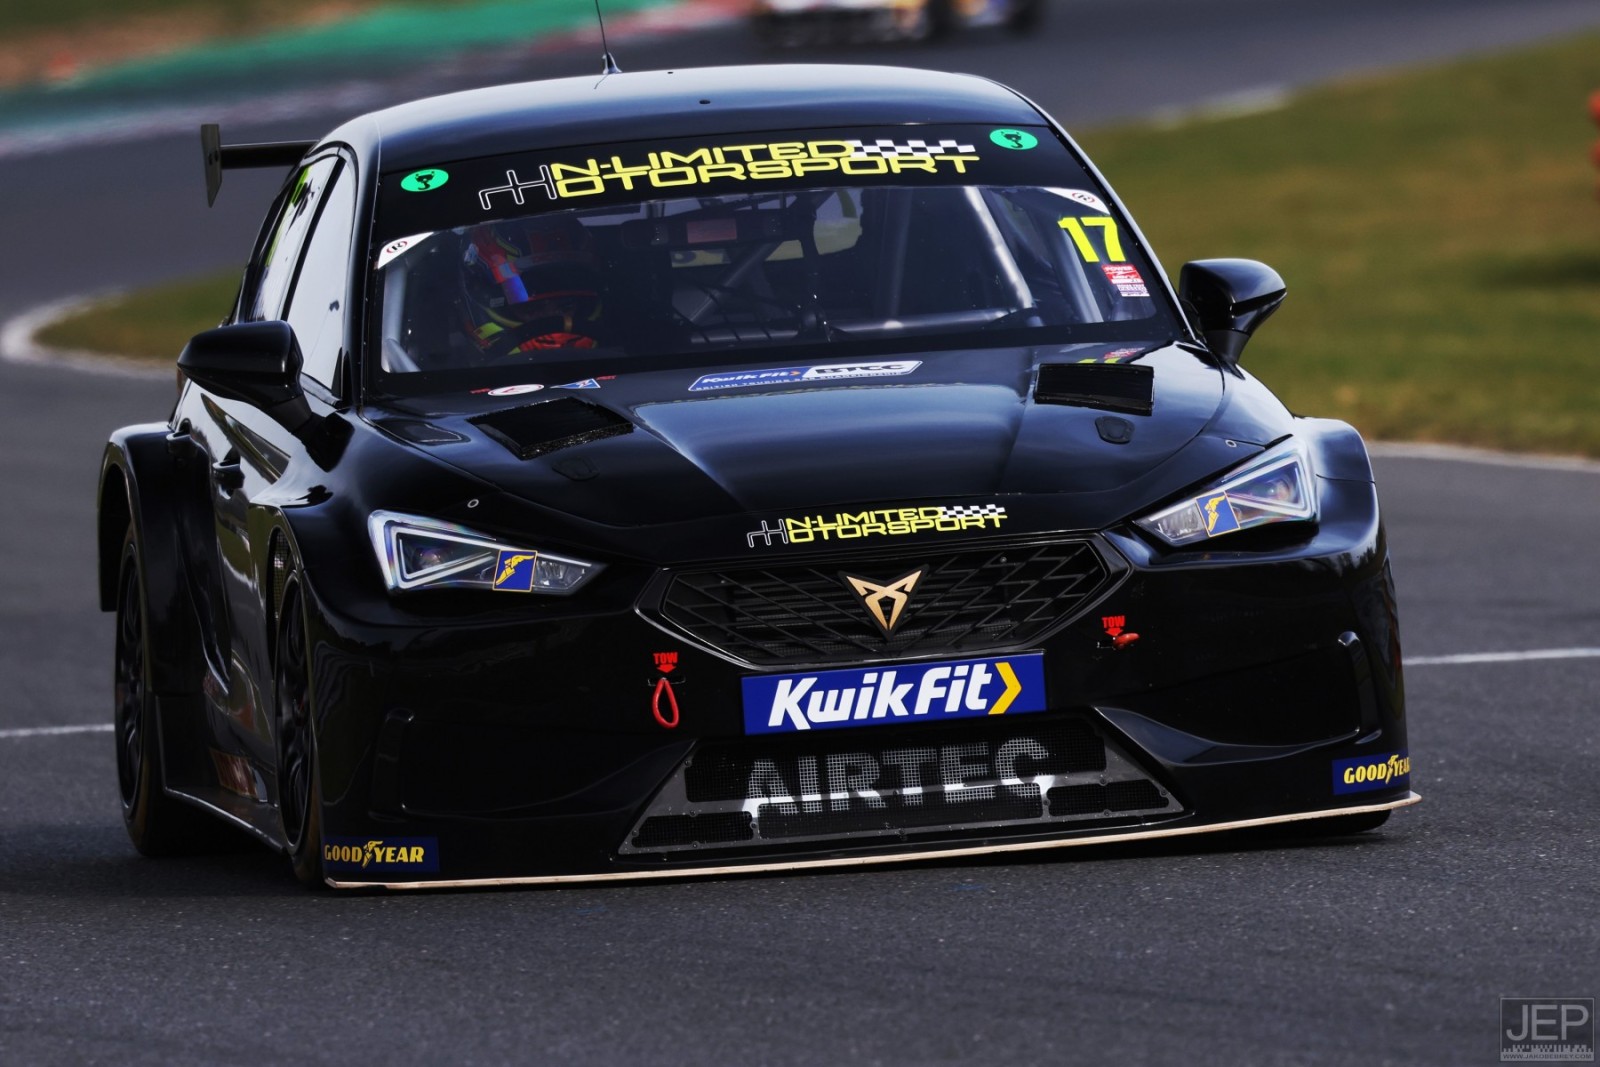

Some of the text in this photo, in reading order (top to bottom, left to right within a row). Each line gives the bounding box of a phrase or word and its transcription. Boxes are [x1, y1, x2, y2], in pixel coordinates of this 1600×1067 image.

[1057, 216, 1126, 263] 17
[1102, 615, 1125, 628] TOW
[653, 651, 678, 664] TOW
[742, 737, 1056, 818] AIRTEC
[324, 843, 425, 864] GOODYEAR
